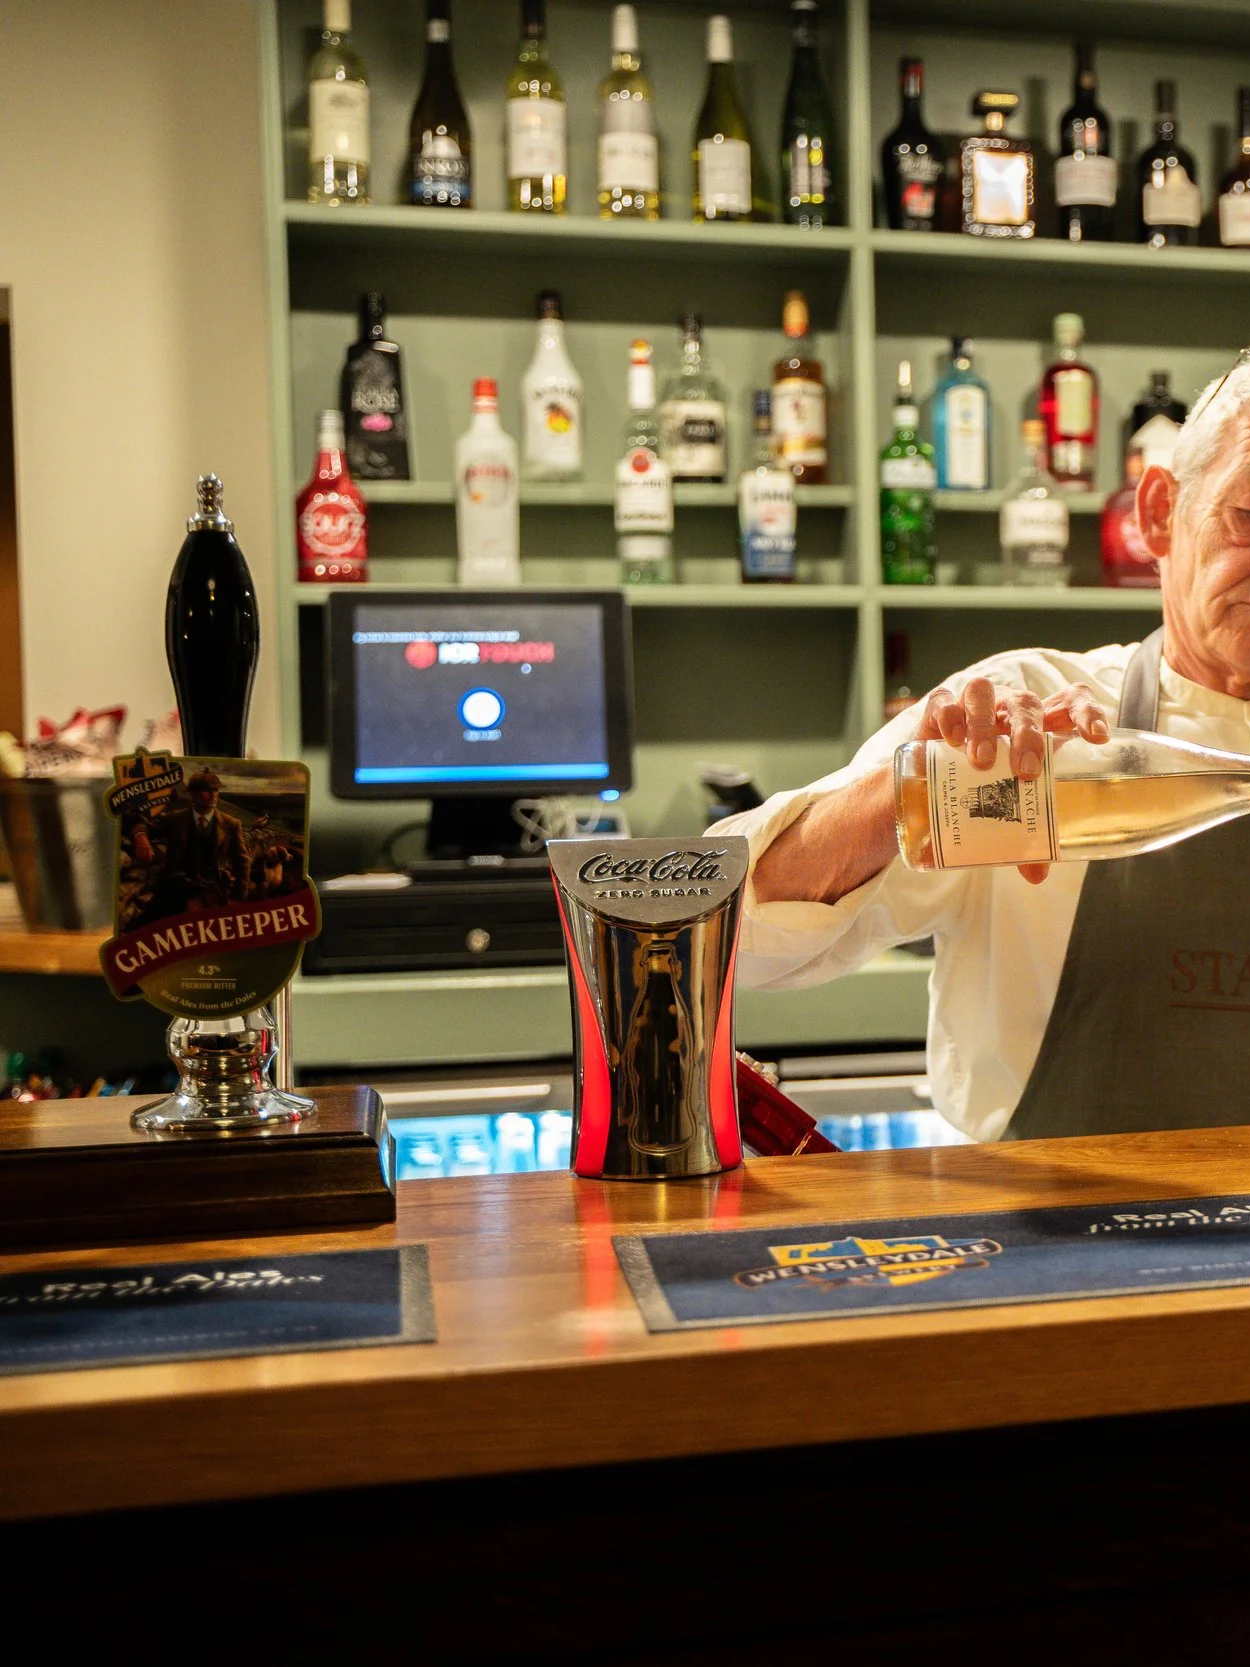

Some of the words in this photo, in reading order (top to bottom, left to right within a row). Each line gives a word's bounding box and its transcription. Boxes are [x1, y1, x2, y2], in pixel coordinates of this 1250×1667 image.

[112, 770, 181, 807] WENSLEYDALE
[948, 761, 957, 792] VILLA
[950, 796, 961, 846] BLANCHE
[1024, 779, 1037, 834] ENACHE
[577, 849, 728, 886] Coca-Cola
[594, 889, 644, 900] ZERO
[650, 887, 712, 898] SUGAR
[115, 904, 309, 973] GAMEKEEPER
[160, 989, 180, 1002] Real
[180, 998, 198, 1009] Ales
[199, 1001, 219, 1010] from
[221, 1000, 234, 1010] the
[181, 981, 212, 989] PREMIUM
[214, 981, 237, 990] BITTER
[1089, 1218, 1175, 1233] from
[1112, 1208, 1205, 1222] Real
[749, 1242, 992, 1285] WENSLEYDALE
